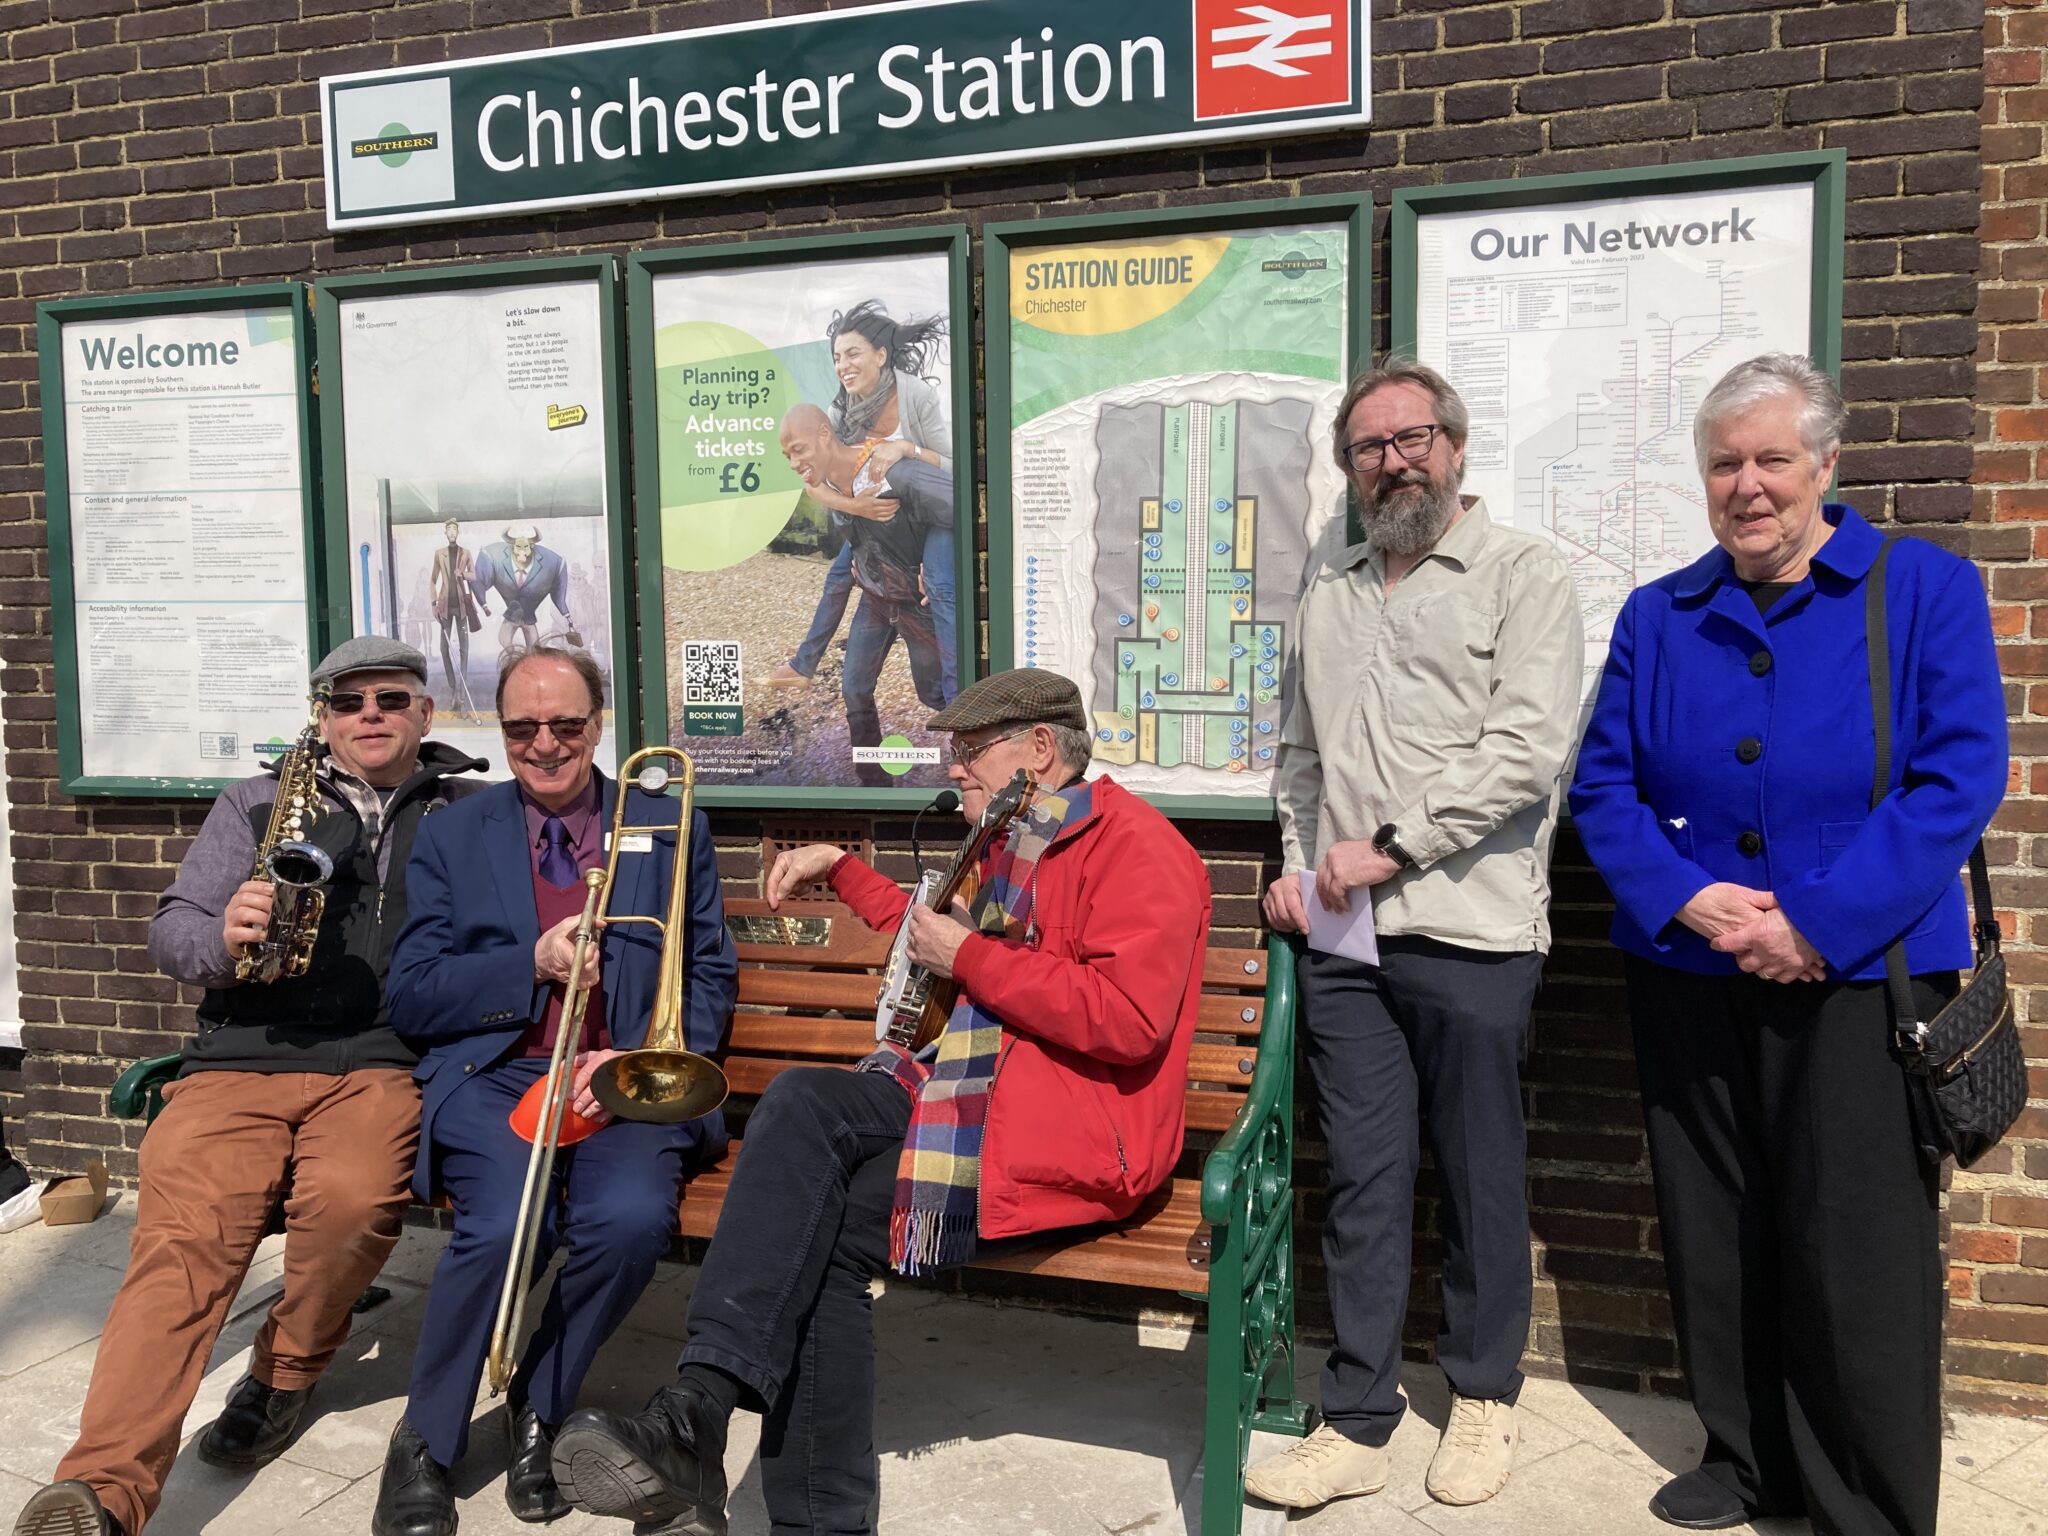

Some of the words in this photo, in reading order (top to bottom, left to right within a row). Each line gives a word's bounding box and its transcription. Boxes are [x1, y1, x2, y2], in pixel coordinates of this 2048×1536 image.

[477, 70, 855, 172] Chichester
[877, 26, 1166, 129] Station
[354, 136, 435, 154] SOUTHERN
[1470, 227, 1549, 262] Our
[1563, 207, 1756, 256] Network
[1264, 261, 1323, 270] SOUTHERN
[1025, 259, 1118, 291] STATION
[1124, 255, 1193, 285] GUIDE
[1025, 298, 1087, 315] Chichester
[1263, 297, 1323, 306] southernrailway.com
[505, 307, 522, 317] Let's
[523, 307, 540, 315] slow
[541, 305, 561, 314] down
[512, 319, 526, 327] bit.
[79, 333, 240, 371] Welcome
[81, 379, 93, 387] This
[93, 378, 114, 387] station
[114, 378, 120, 386] is
[120, 377, 147, 387] operated
[147, 376, 155, 385] by
[155, 375, 184, 384] Southern
[683, 366, 759, 387] Planning
[765, 369, 776, 381] a
[81, 389, 92, 397] The
[106, 388, 133, 397] manager
[133, 386, 166, 396] responsible
[166, 385, 176, 393] for
[177, 384, 189, 393] this
[190, 384, 211, 393] station
[211, 384, 217, 392] is
[217, 383, 241, 391] Hannah
[242, 382, 262, 390] Butler
[688, 389, 721, 410] day
[726, 387, 770, 409] trip?
[81, 405, 111, 414] Catching
[116, 403, 132, 412] train
[549, 408, 580, 420] everyone's
[684, 413, 775, 434] Advance
[695, 437, 766, 458] tickets
[688, 464, 715, 476] from
[84, 496, 111, 504] Contact
[111, 495, 124, 503] and
[125, 495, 149, 504] general
[150, 494, 188, 503] information
[88, 604, 128, 614] Accessibility
[128, 604, 167, 612] information
[688, 711, 714, 720] BOOK
[715, 711, 738, 720] NOW
[714, 724, 728, 732] apply
[685, 747, 697, 756] Buy
[698, 748, 713, 756] your
[714, 747, 736, 755] tickets
[737, 748, 757, 756] direct
[757, 747, 779, 756] before
[780, 750, 793, 758] you
[856, 751, 936, 760] SOUTHERN
[729, 757, 757, 766] booking
[757, 757, 772, 765] fees
